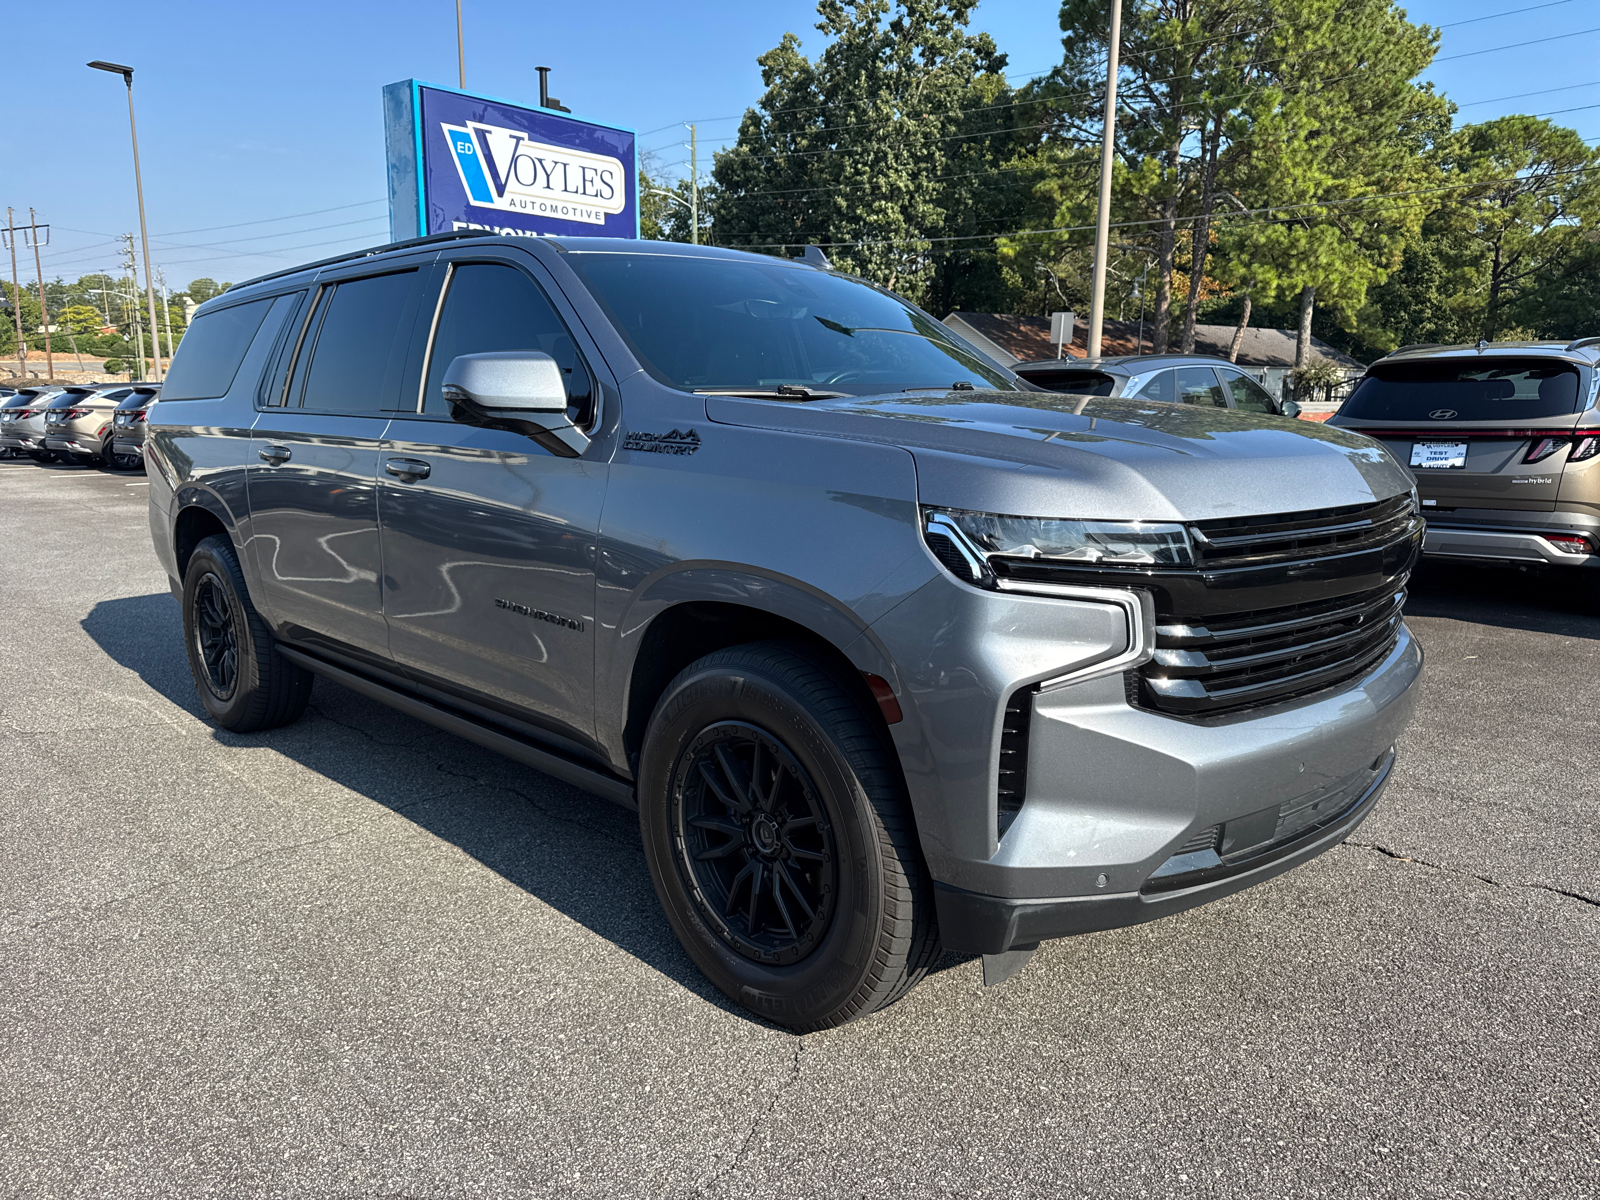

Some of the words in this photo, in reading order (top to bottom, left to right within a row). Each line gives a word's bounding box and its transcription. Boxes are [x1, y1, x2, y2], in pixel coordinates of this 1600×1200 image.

[457, 141, 474, 155] ED
[472, 127, 615, 201] VOYLES
[509, 198, 602, 221] AUTOMOTIVE
[626, 431, 665, 442] HIGH
[622, 441, 699, 456] COUNTRY
[494, 597, 585, 633] SUBURBAN
